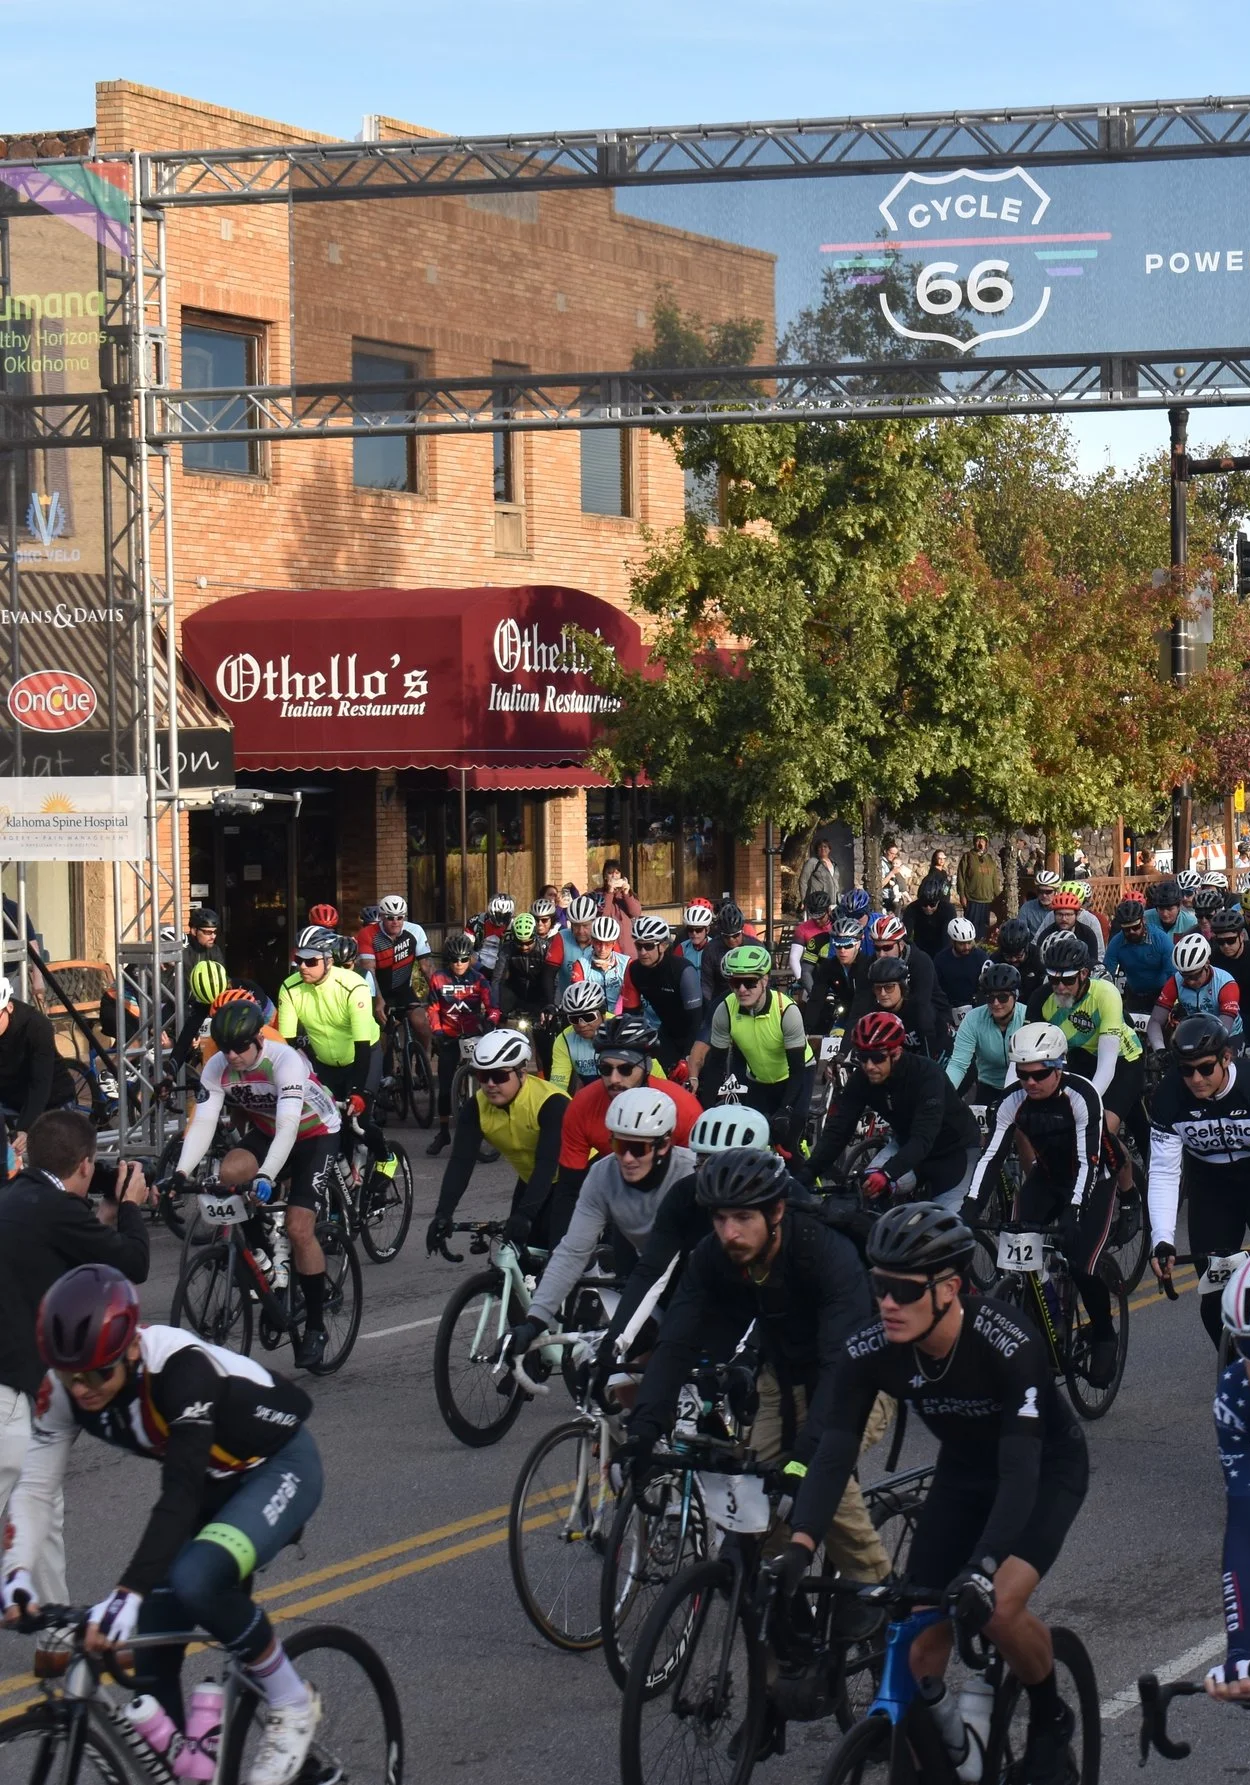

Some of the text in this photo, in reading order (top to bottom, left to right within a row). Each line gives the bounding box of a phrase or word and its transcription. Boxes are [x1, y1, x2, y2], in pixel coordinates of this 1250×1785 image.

[908, 194, 1023, 228] CYCLE
[916, 259, 1014, 314] 66
[4, 355, 90, 373] Oklahoma
[215, 652, 429, 702] Othello's
[14, 683, 91, 716] OnCue
[488, 682, 540, 713] Italian
[279, 700, 426, 718] Italian Restaurant
[52, 815, 82, 831] Spine
[84, 815, 128, 831] Hospital
[394, 938, 411, 953] PHAT
[394, 949, 409, 962] TIRE
[442, 985, 475, 995] PRT
[1187, 1136, 1245, 1150] Cycles
[206, 1204, 236, 1218] 344
[1007, 1244, 1034, 1262] 712
[979, 1304, 1031, 1345] EN PASSANT
[974, 1314, 1020, 1359] RACING
[1222, 1571, 1240, 1633] UNITED
